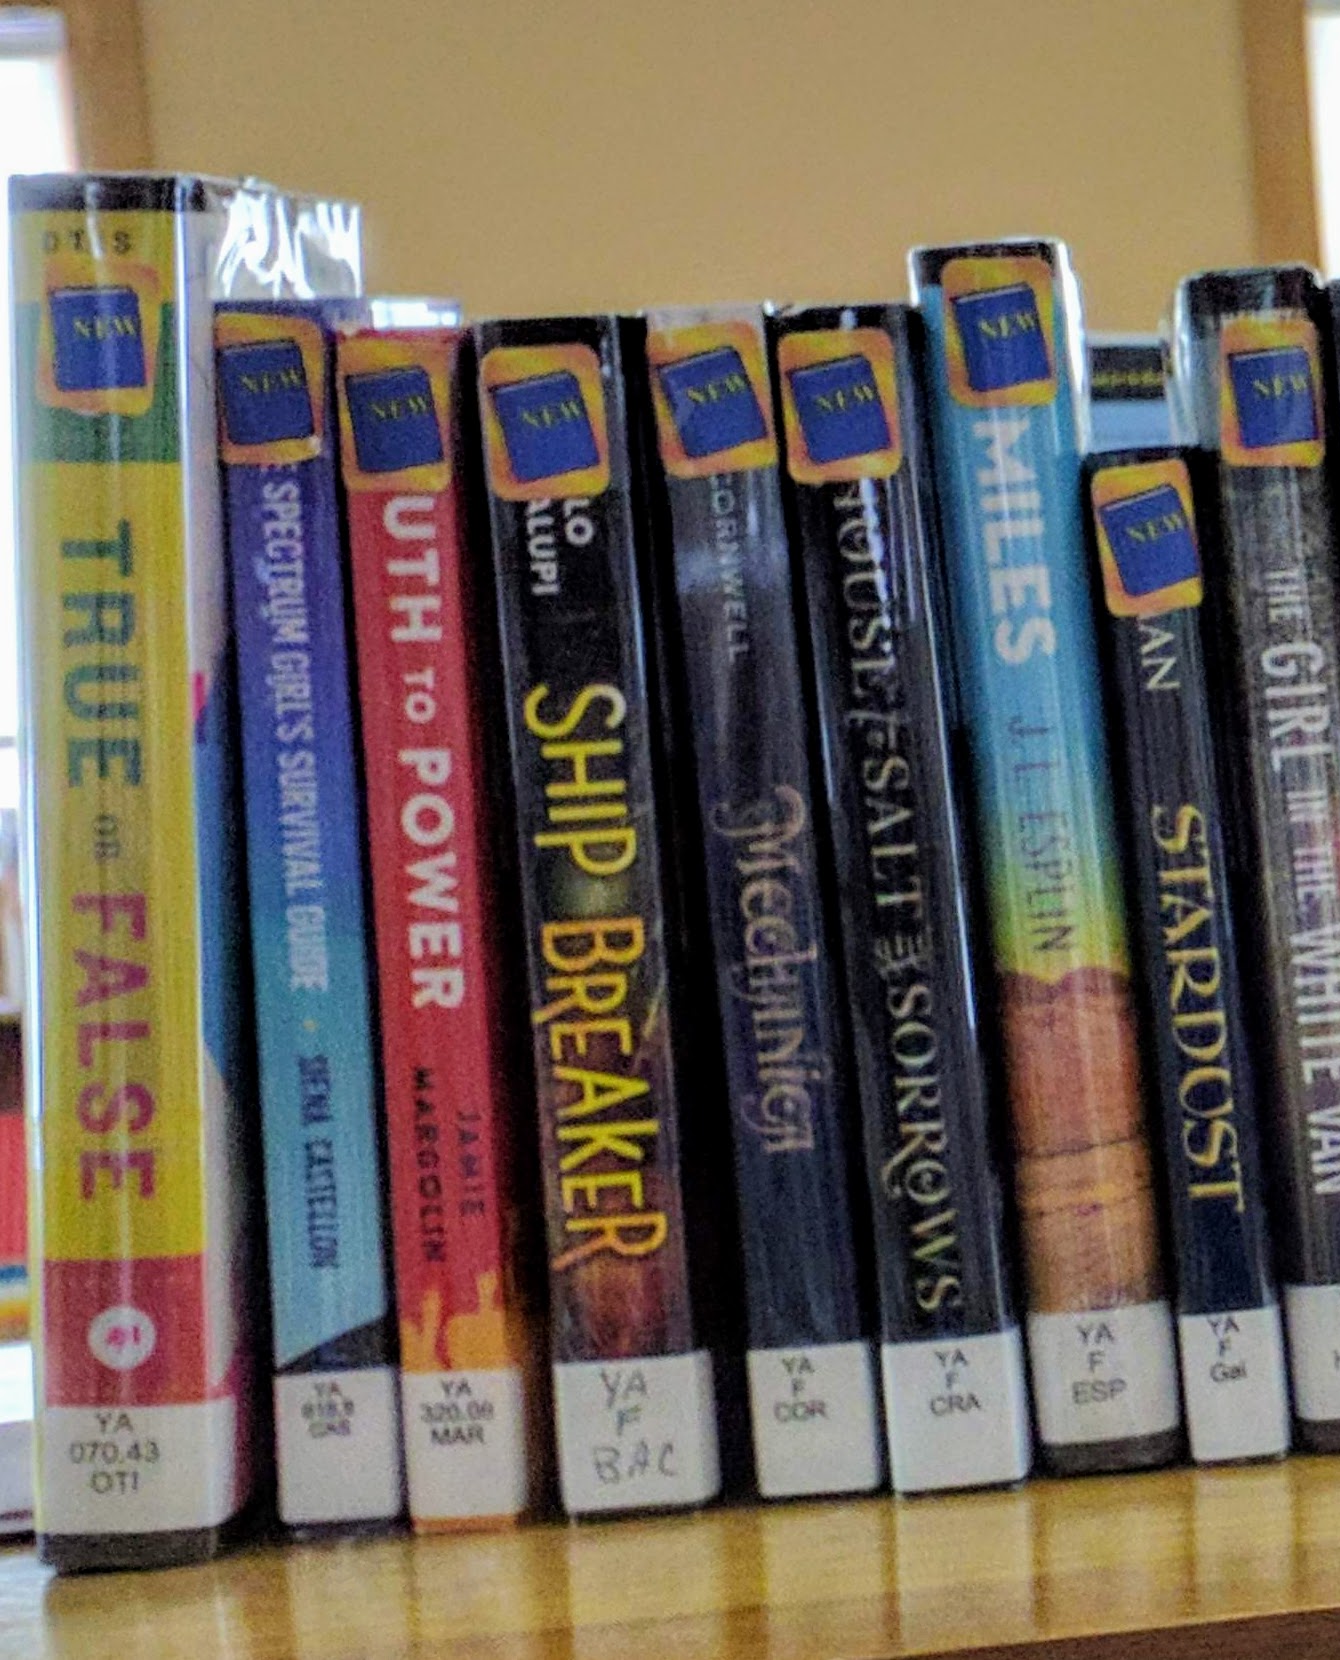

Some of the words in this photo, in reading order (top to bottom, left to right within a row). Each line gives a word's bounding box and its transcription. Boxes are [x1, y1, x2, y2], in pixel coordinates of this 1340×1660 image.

[978, 312, 1036, 340] NEW
[239, 368, 303, 394] NEW
[686, 374, 746, 403] NEW
[1253, 373, 1311, 398] NEW
[370, 395, 432, 421] NEW
[815, 383, 874, 414] NEW
[520, 400, 583, 428] NEW
[1125, 512, 1186, 541] NEW
[973, 418, 1058, 666] MILES
[262, 482, 309, 642] SPECTRUM
[382, 495, 444, 643] UTH
[60, 519, 144, 789] TRUE
[404, 673, 437, 723] TO
[1262, 643, 1334, 772] GIRL
[524, 682, 637, 876] SHIP
[278, 751, 324, 898] SURVIVAL
[863, 758, 924, 917] SALT
[398, 748, 468, 1010] POWER
[1152, 803, 1246, 1213] STARDUST
[70, 891, 157, 1202] FALSE
[533, 917, 669, 1271] BREAKER
[882, 982, 961, 1313] SORROWS
[1076, 1324, 1114, 1344] YA
[1206, 1317, 1240, 1334] YA
[935, 1351, 967, 1369] YA
[1219, 1339, 1231, 1355] F
[782, 1356, 815, 1375] YA
[1089, 1351, 1105, 1373] F
[441, 1378, 471, 1397] YA
[599, 1370, 648, 1405] YA
[792, 1378, 805, 1397] F
[945, 1371, 958, 1388] F
[1072, 1380, 1126, 1404] ESP
[96, 1413, 134, 1433] YA
[614, 1405, 641, 1431] F
[431, 1423, 485, 1445] MAR
[91, 1471, 140, 1494] OTI
